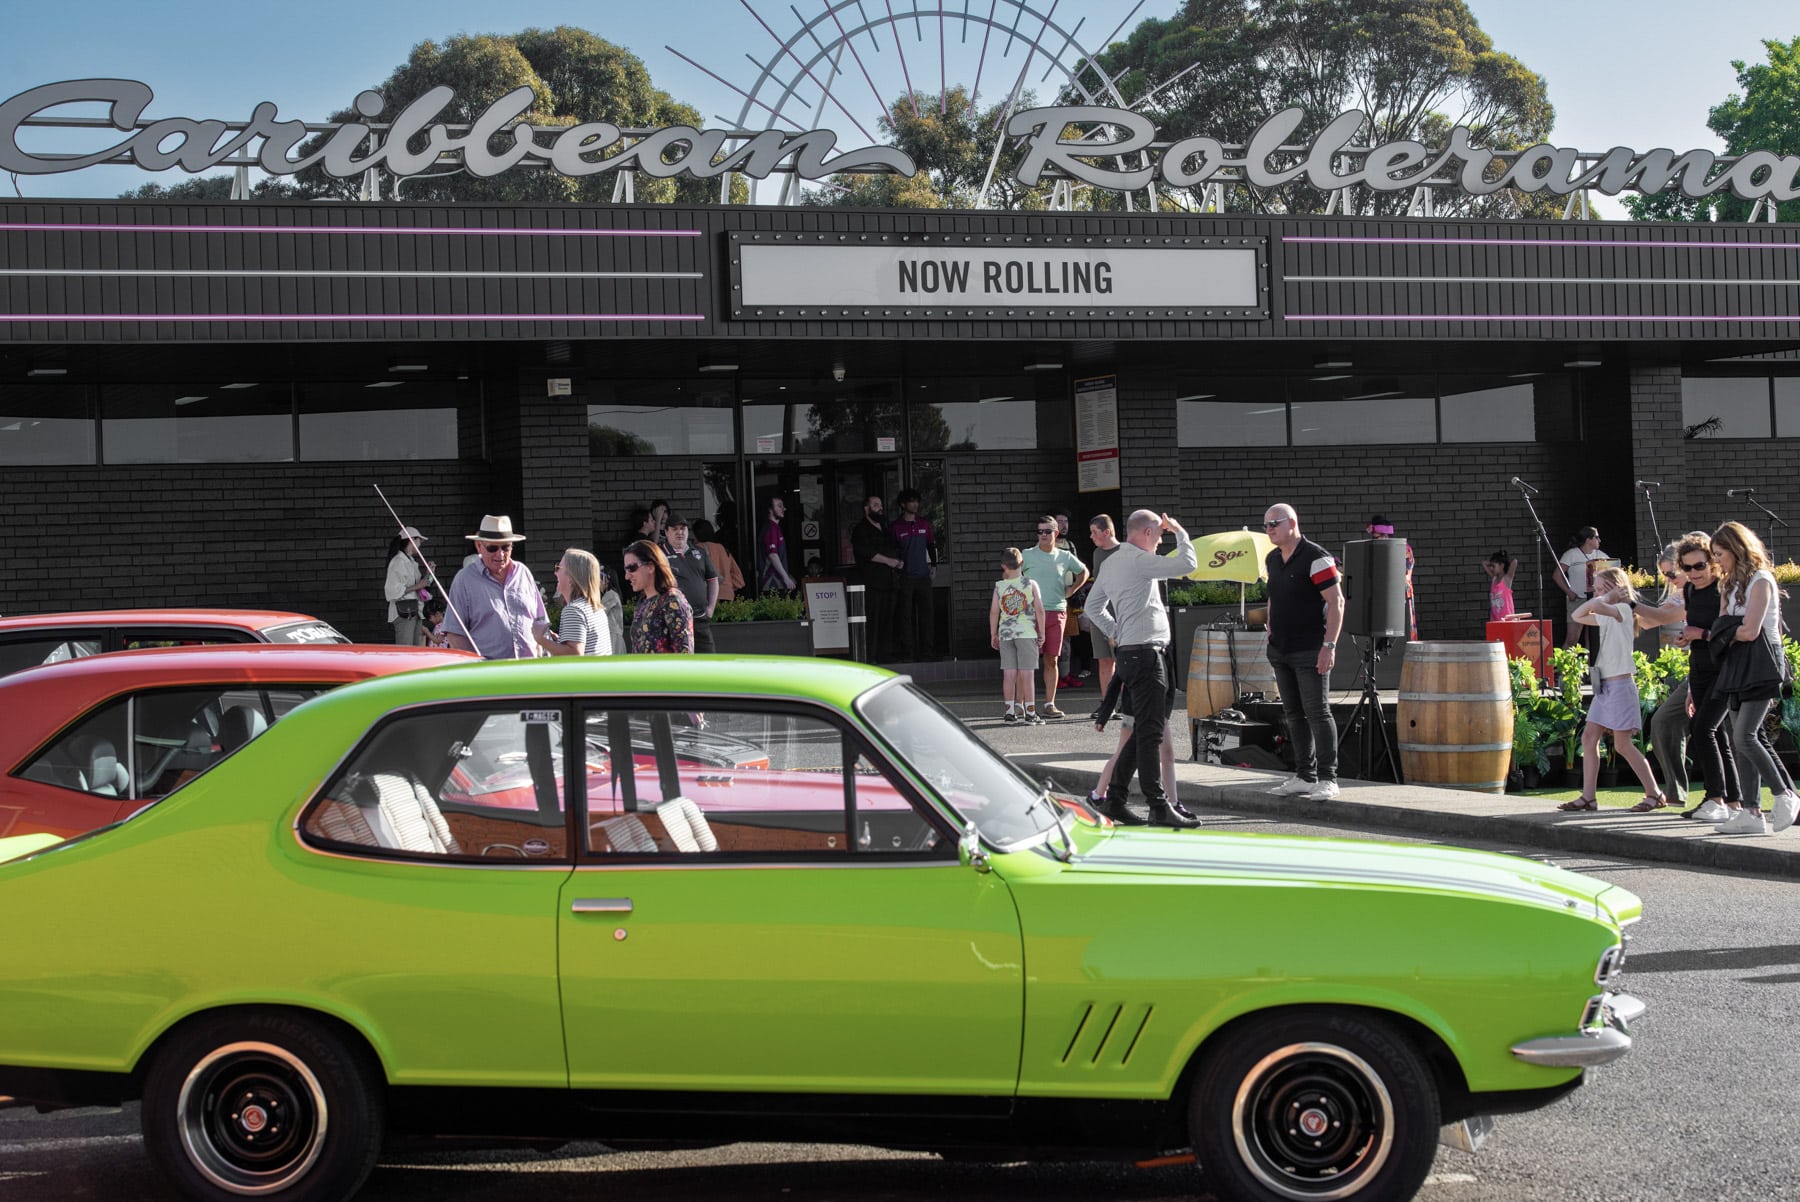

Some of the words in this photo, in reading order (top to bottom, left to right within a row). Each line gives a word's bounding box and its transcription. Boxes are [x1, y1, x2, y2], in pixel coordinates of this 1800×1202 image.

[0, 78, 916, 178] Caribbean
[1004, 105, 1800, 201] Rollerama
[899, 260, 970, 293] NOW
[983, 261, 1113, 294] ROLLING
